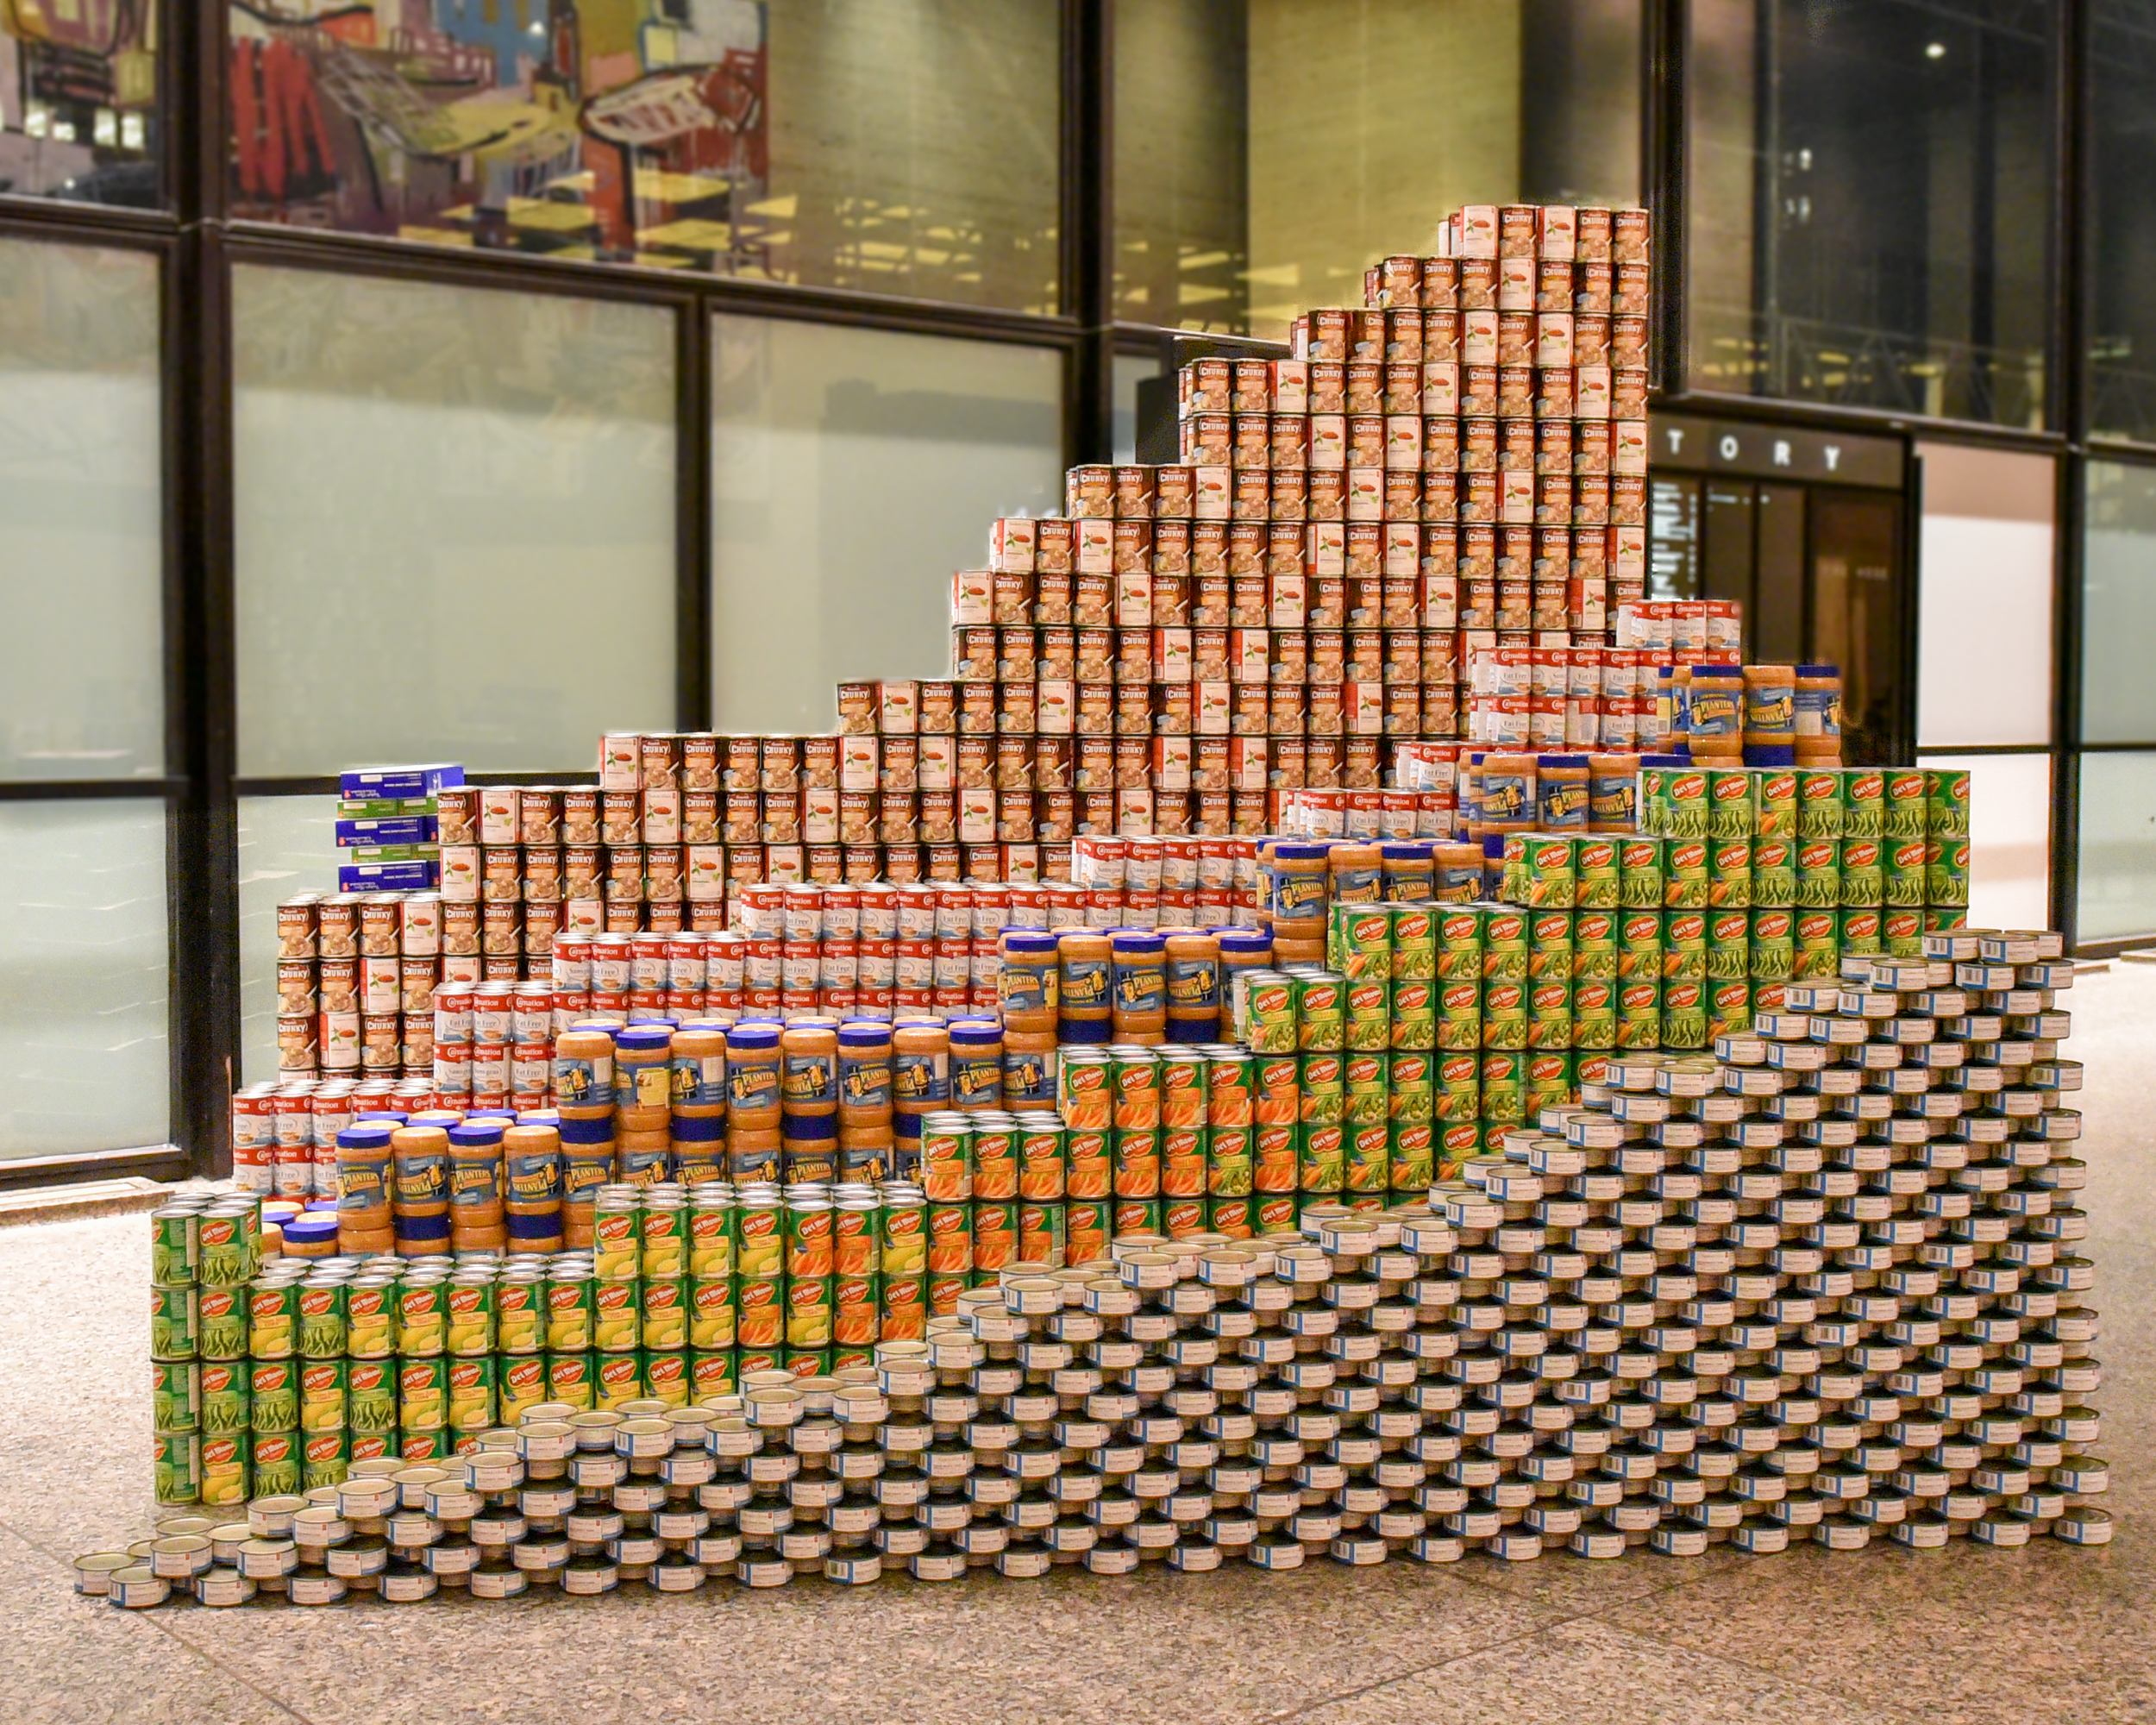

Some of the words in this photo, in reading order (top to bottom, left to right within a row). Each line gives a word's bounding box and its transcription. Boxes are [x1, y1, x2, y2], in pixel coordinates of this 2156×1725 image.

[1505, 215, 1532, 224] CHUNKY
[1463, 267, 1489, 275] CHUNKY
[1544, 268, 1571, 278] CHUNKY
[1202, 368, 1228, 377] CHUNKY
[1239, 368, 1267, 378] CHUNKY
[1201, 423, 1229, 431] CHUNKY
[1239, 423, 1267, 433] CHUNKY
[1240, 476, 1268, 485] CHUNKY
[1427, 479, 1455, 488] CHUNKY
[1043, 527, 1070, 536] CHUNKY
[1158, 530, 1186, 538] CHUNKY
[1272, 532, 1298, 541] CHUNKY
[1079, 582, 1106, 592] CHUNKY
[1237, 584, 1264, 593] CHUNKY
[1006, 636, 1034, 645] CHUNKY
[1198, 637, 1225, 647] CHUNKY
[841, 691, 868, 700] CHUNKY
[1006, 689, 1034, 699] CHUNKY
[1083, 691, 1111, 700] CHUNKY
[1312, 691, 1339, 700] CHUNKY
[686, 745, 714, 754] CHUNKY
[807, 746, 835, 756] CHUNKY
[1674, 785, 1686, 796] Del
[567, 800, 594, 809] CHUNKY
[605, 800, 633, 809] CHUNKY
[729, 799, 758, 808] CHUNKY
[528, 856, 557, 865] CHUNKY
[614, 856, 642, 864] CHUNKY
[733, 855, 761, 864] CHUNKY
[1538, 855, 1550, 866] Del
[1582, 854, 1594, 865] Del
[1719, 855, 1731, 866] Del
[1846, 853, 1858, 864] Del
[279, 913, 306, 923] CHUNKY
[362, 911, 392, 920] CHUNKY
[446, 910, 475, 919] CHUNKY
[694, 908, 722, 918] CHUNKY
[1357, 926, 1369, 938] Del
[1445, 925, 1457, 937] Del
[1490, 926, 1502, 938] Del
[1626, 926, 1639, 938] Del
[279, 970, 307, 980] CHUNKY
[404, 968, 431, 976] CHUNKY
[488, 966, 517, 975] CHUNKY
[1305, 996, 1317, 1007] Del
[1351, 995, 1363, 1007] Del
[1445, 995, 1457, 1007] Del
[1668, 994, 1680, 1006] Del
[367, 1022, 397, 1032] CHUNKY
[1073, 1076, 1085, 1088] Del
[1122, 1076, 1134, 1087] Del
[1402, 1135, 1413, 1146] Del
[1025, 1145, 1037, 1156] Del
[1214, 1142, 1226, 1153] Del
[744, 1222, 756, 1233] Del
[890, 1220, 902, 1232] Del
[599, 1226, 611, 1237] Del
[792, 1291, 804, 1302] Del
[887, 1290, 899, 1302] Del
[404, 1300, 416, 1311] Del
[604, 1370, 616, 1381] Del
